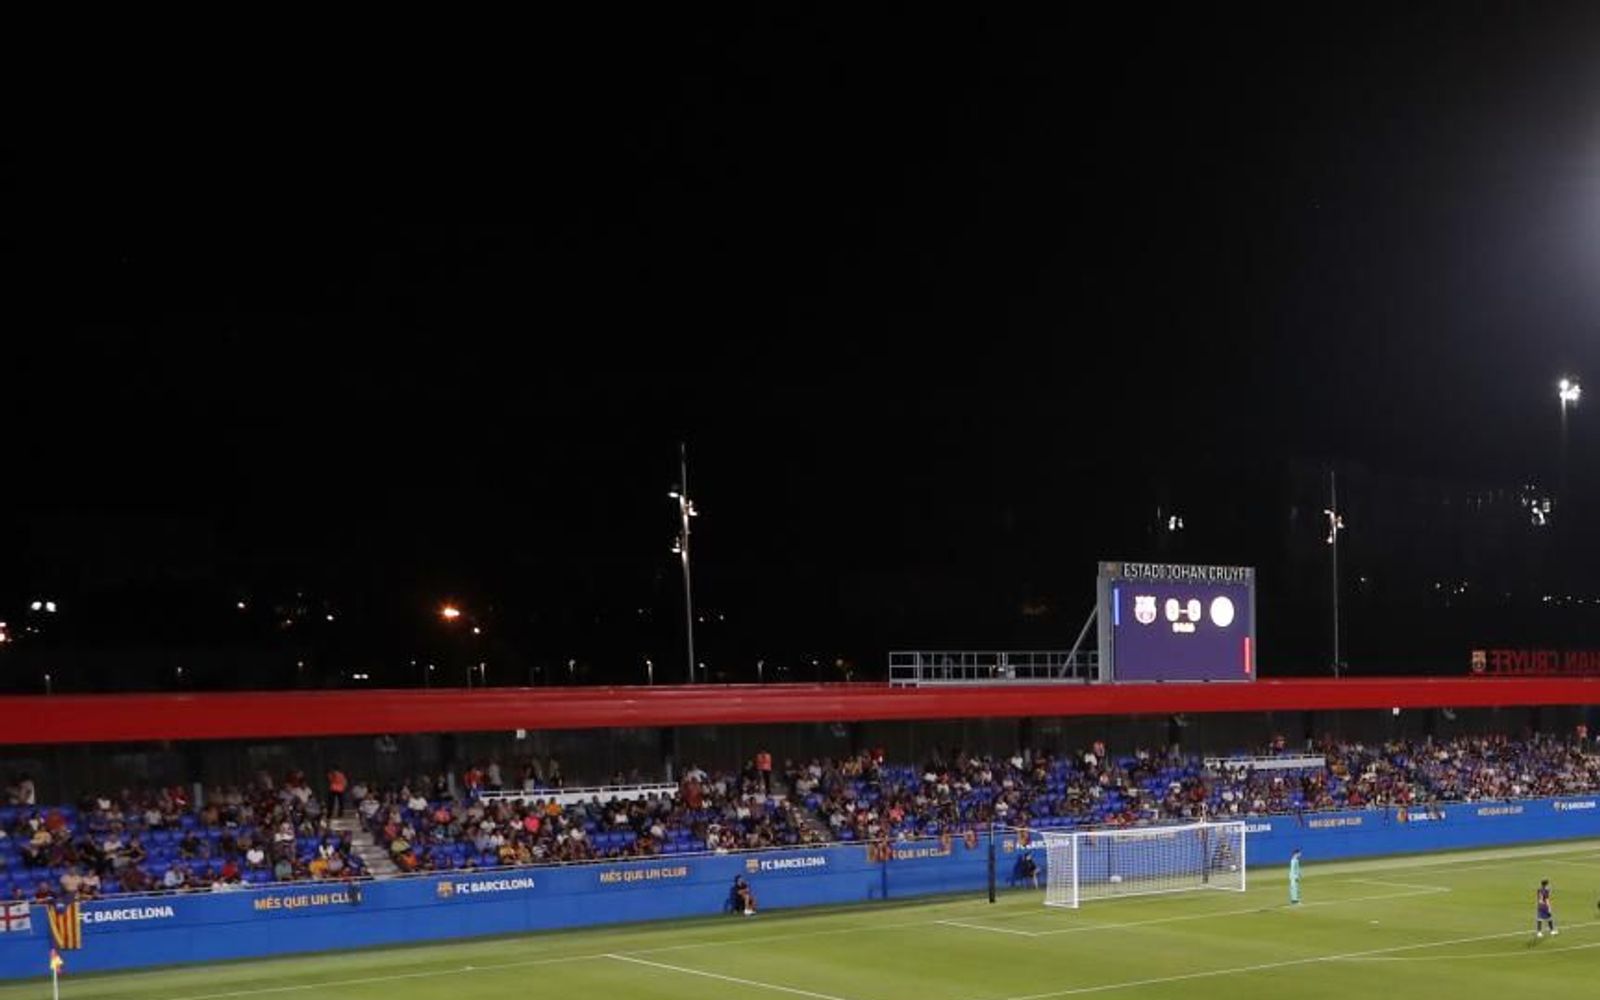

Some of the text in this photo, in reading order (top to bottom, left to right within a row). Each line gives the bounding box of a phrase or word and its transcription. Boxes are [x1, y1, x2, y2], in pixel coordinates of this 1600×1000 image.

[1123, 563, 1165, 578] ESTADI
[1168, 564, 1207, 579] JOHAN
[456, 877, 535, 894] FC BARCELONA
[253, 891, 361, 911] MÉS QUE UN CLU
[94, 905, 175, 923] BARCELONA
